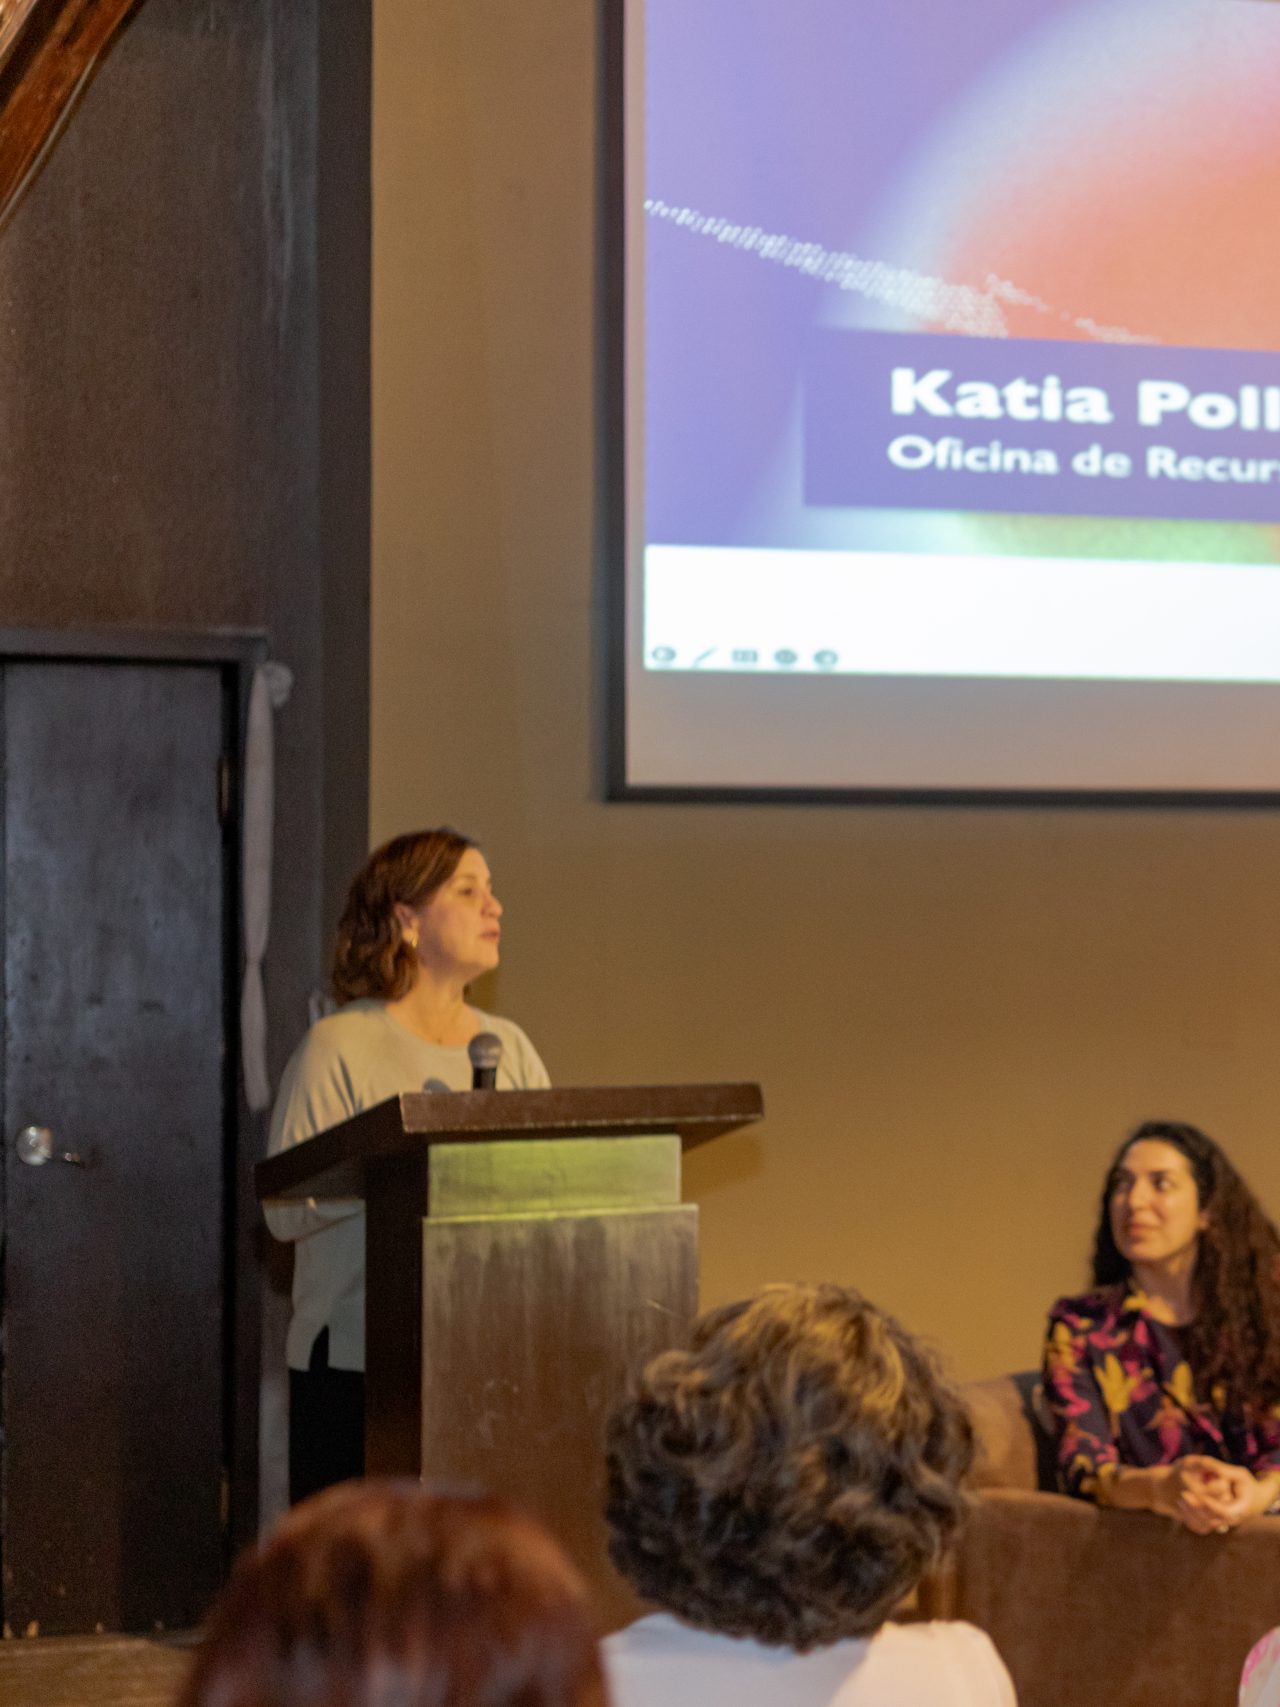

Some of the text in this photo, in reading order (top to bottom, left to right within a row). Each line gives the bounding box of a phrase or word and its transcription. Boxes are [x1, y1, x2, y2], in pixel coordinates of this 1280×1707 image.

[890, 367, 1113, 424] Katia
[887, 434, 1059, 475] Oficina
[1072, 444, 1132, 478] de
